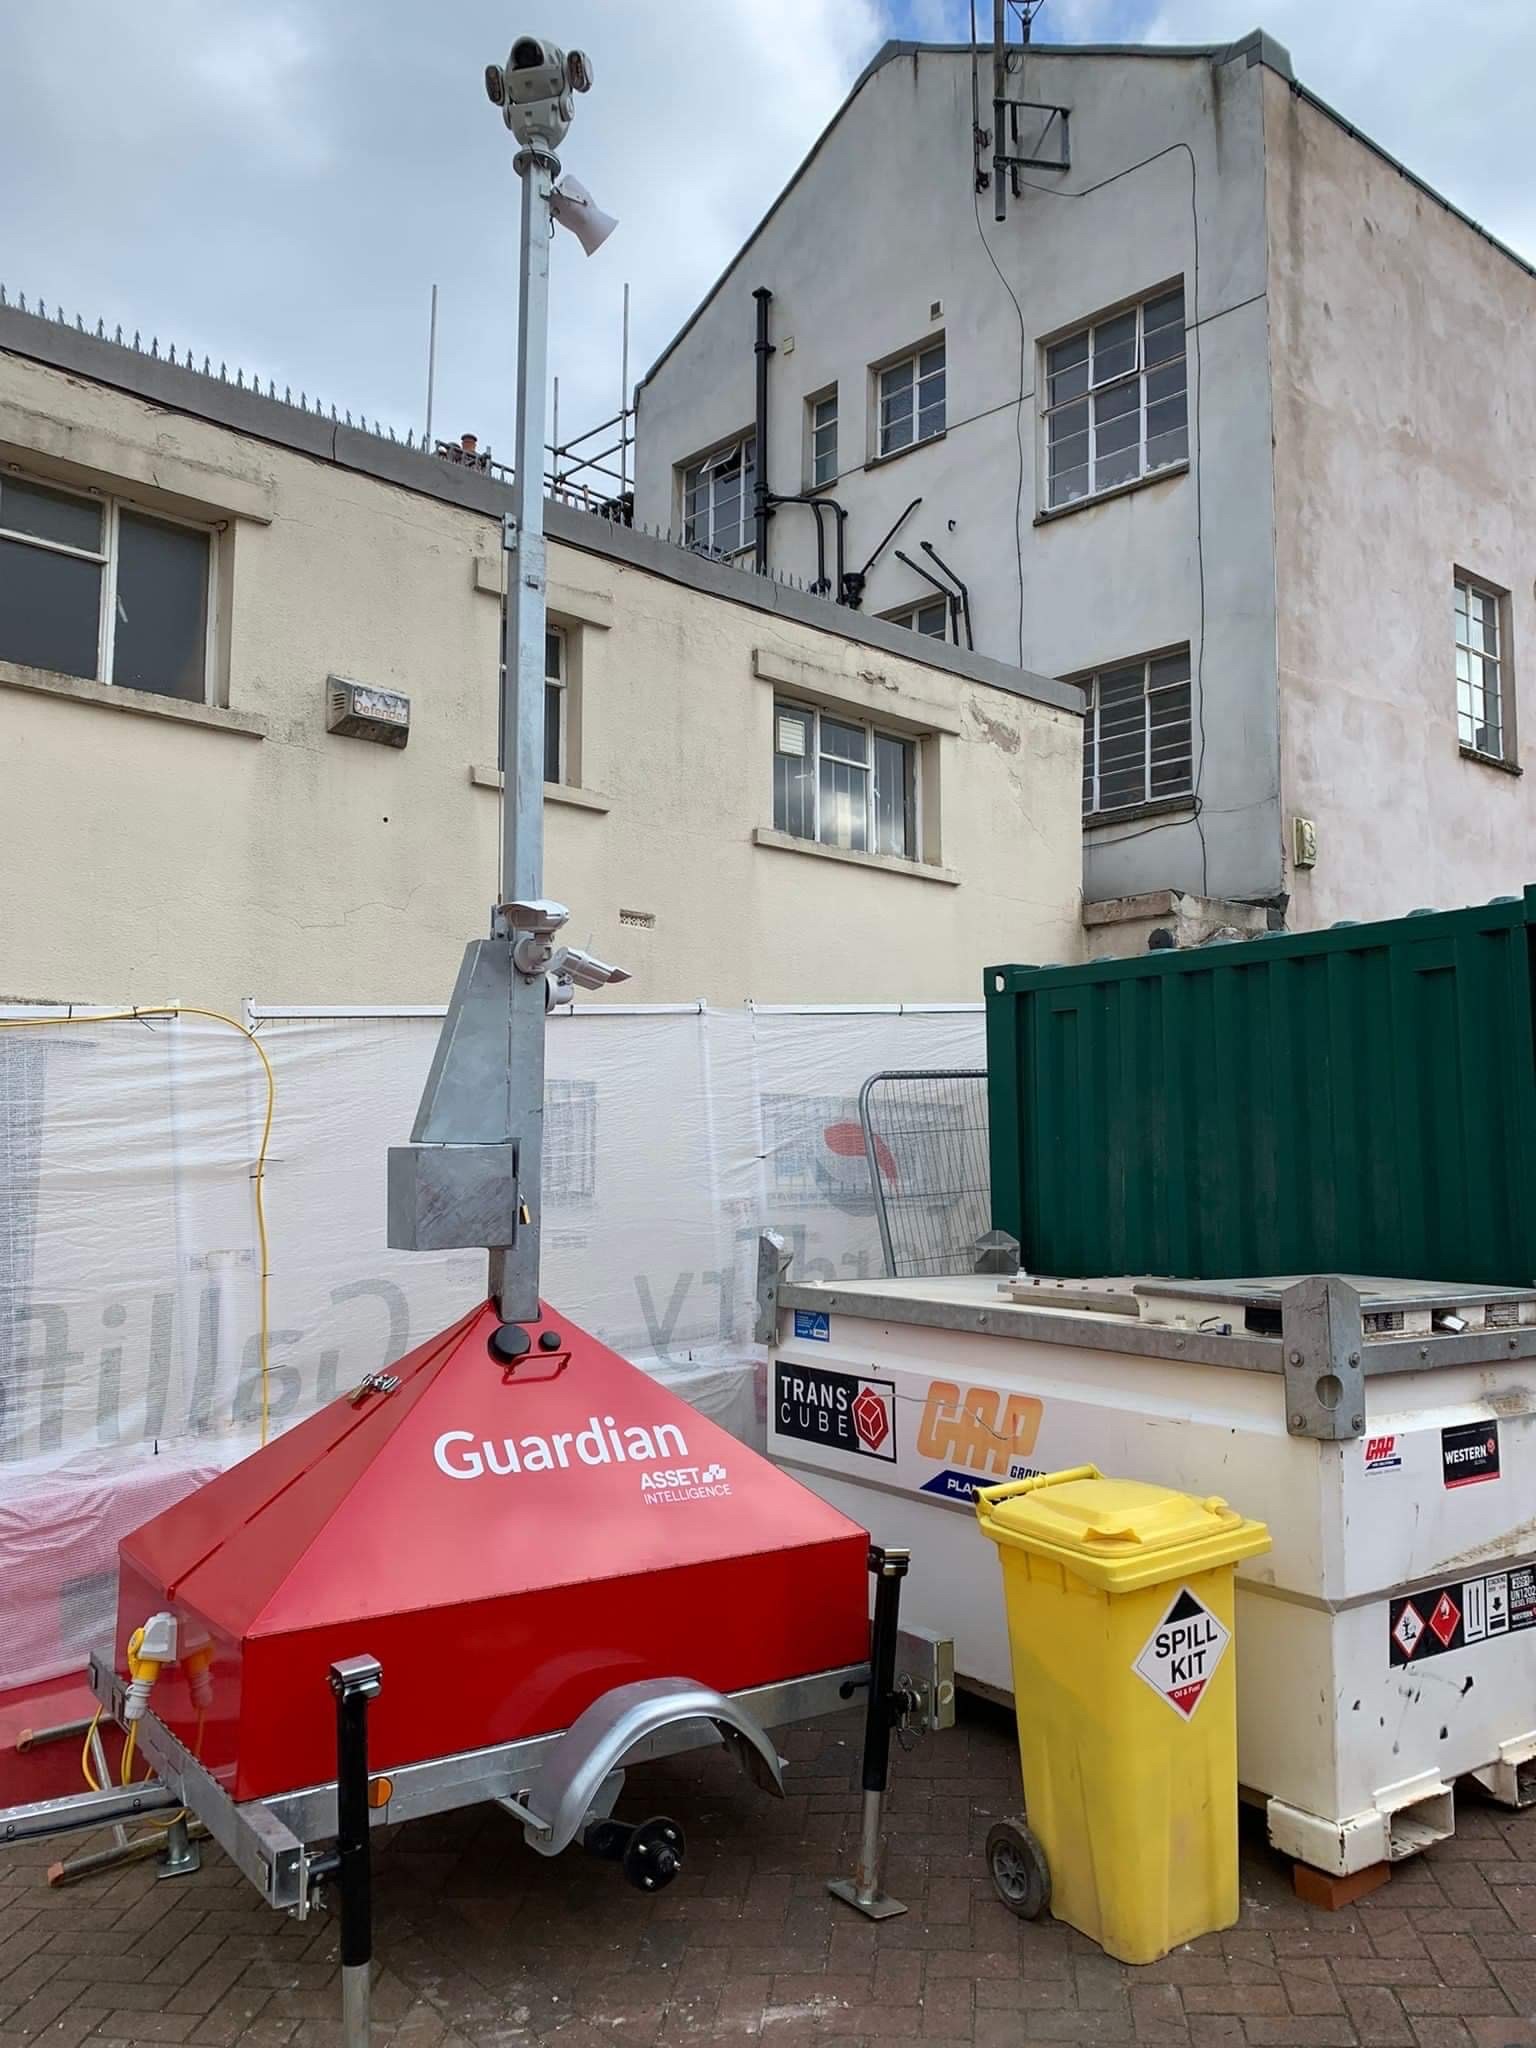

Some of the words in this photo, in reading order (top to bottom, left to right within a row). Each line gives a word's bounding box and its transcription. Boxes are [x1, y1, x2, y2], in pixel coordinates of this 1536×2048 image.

[780, 1375, 848, 1412] TRANS
[780, 1402, 849, 1437] CUBE
[433, 1416, 689, 1480] Guardian
[1444, 1444, 1488, 1465] WESTERN
[640, 1467, 700, 1490] ASSET
[643, 1484, 733, 1505] INTELLIGENCE
[1155, 1619, 1218, 1658] SPILL
[1171, 1649, 1207, 1683] KIT
[1174, 1690, 1183, 1698] Oil
